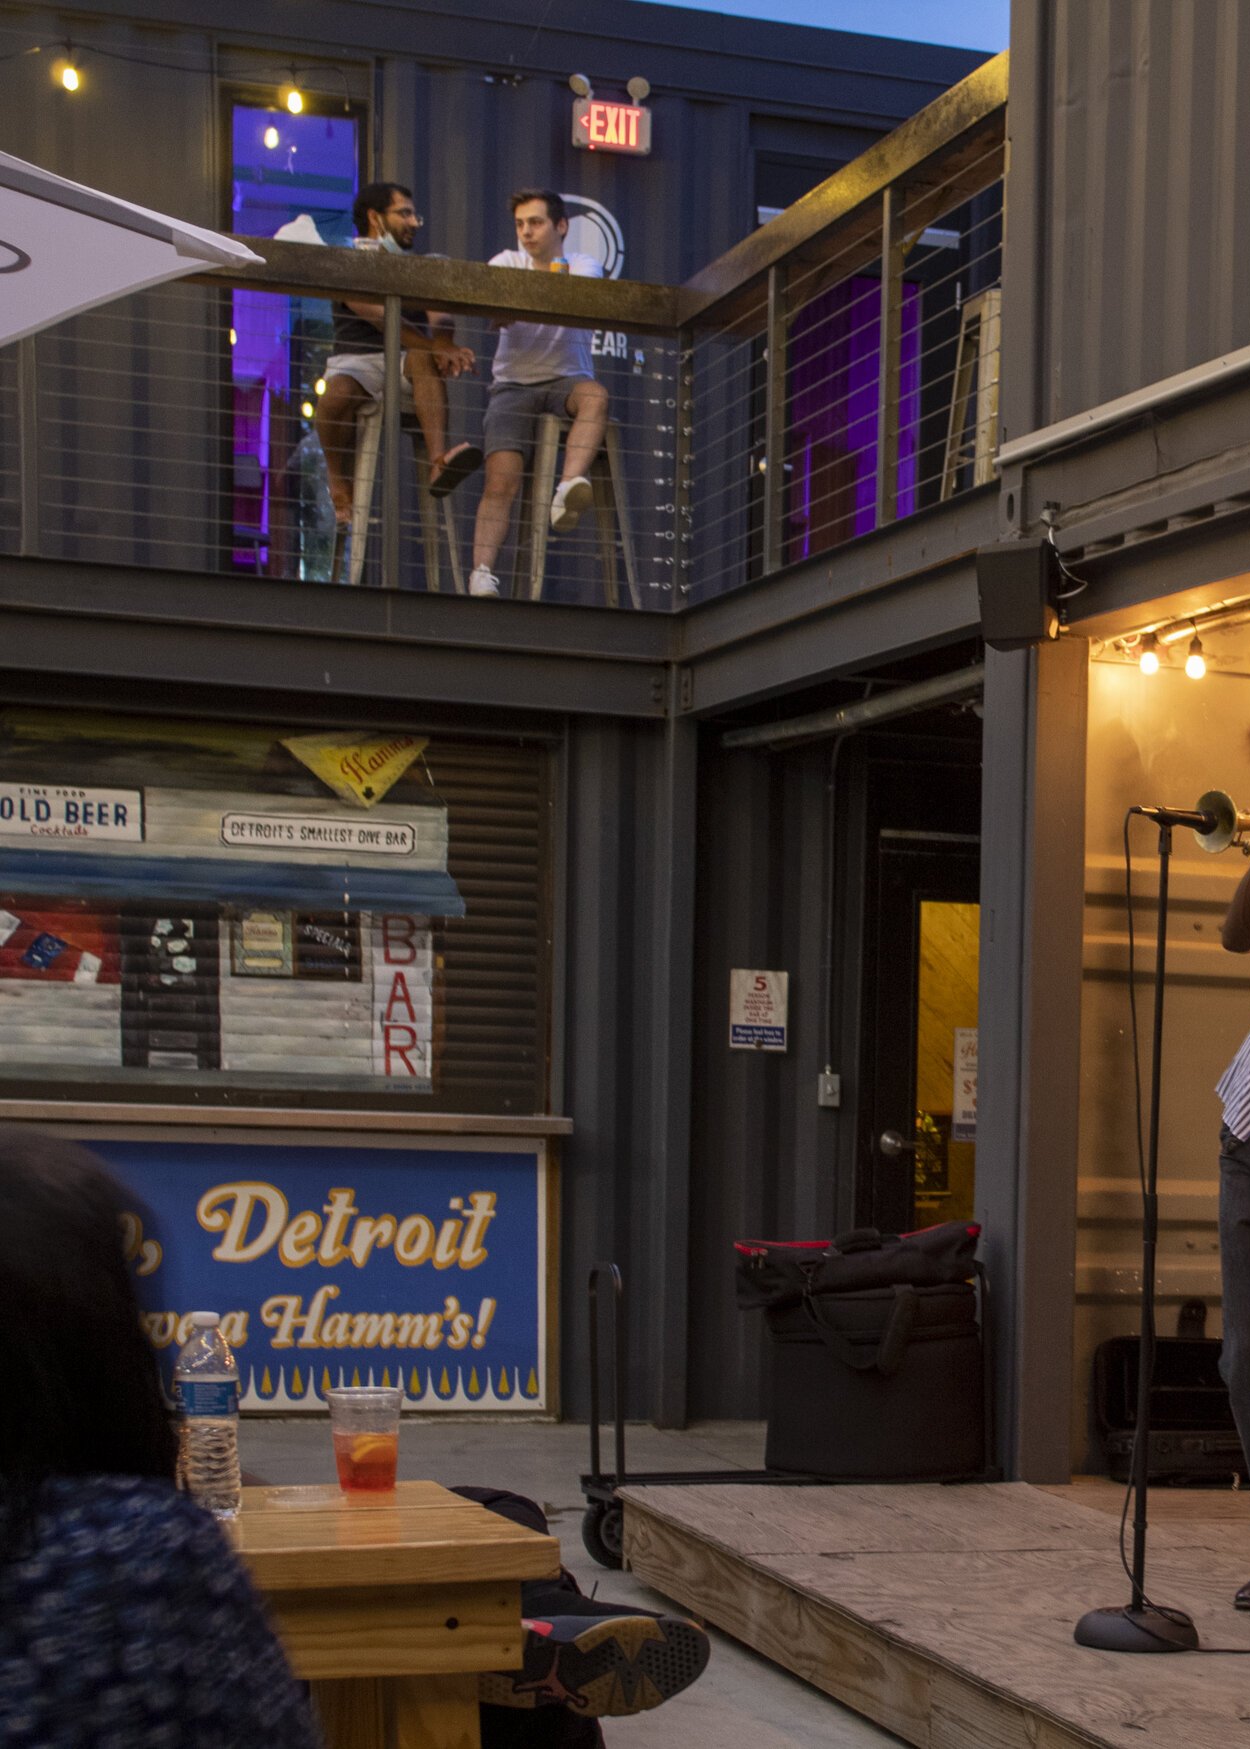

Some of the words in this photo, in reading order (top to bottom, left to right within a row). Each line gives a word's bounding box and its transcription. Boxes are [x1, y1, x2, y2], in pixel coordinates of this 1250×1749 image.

[590, 104, 640, 146] EXIT
[20, 787, 48, 796] FINE
[56, 789, 86, 798] FOOD
[0, 796, 51, 822] OLD
[65, 800, 128, 827] BEER
[231, 821, 294, 840] DETROIT'S
[301, 826, 353, 843] SMALLEST
[386, 831, 407, 846] BAR
[382, 914, 417, 1077] BAR
[753, 976, 767, 991] 5
[197, 1180, 497, 1270] Detroit
[260, 1284, 497, 1350] Hamm's!
